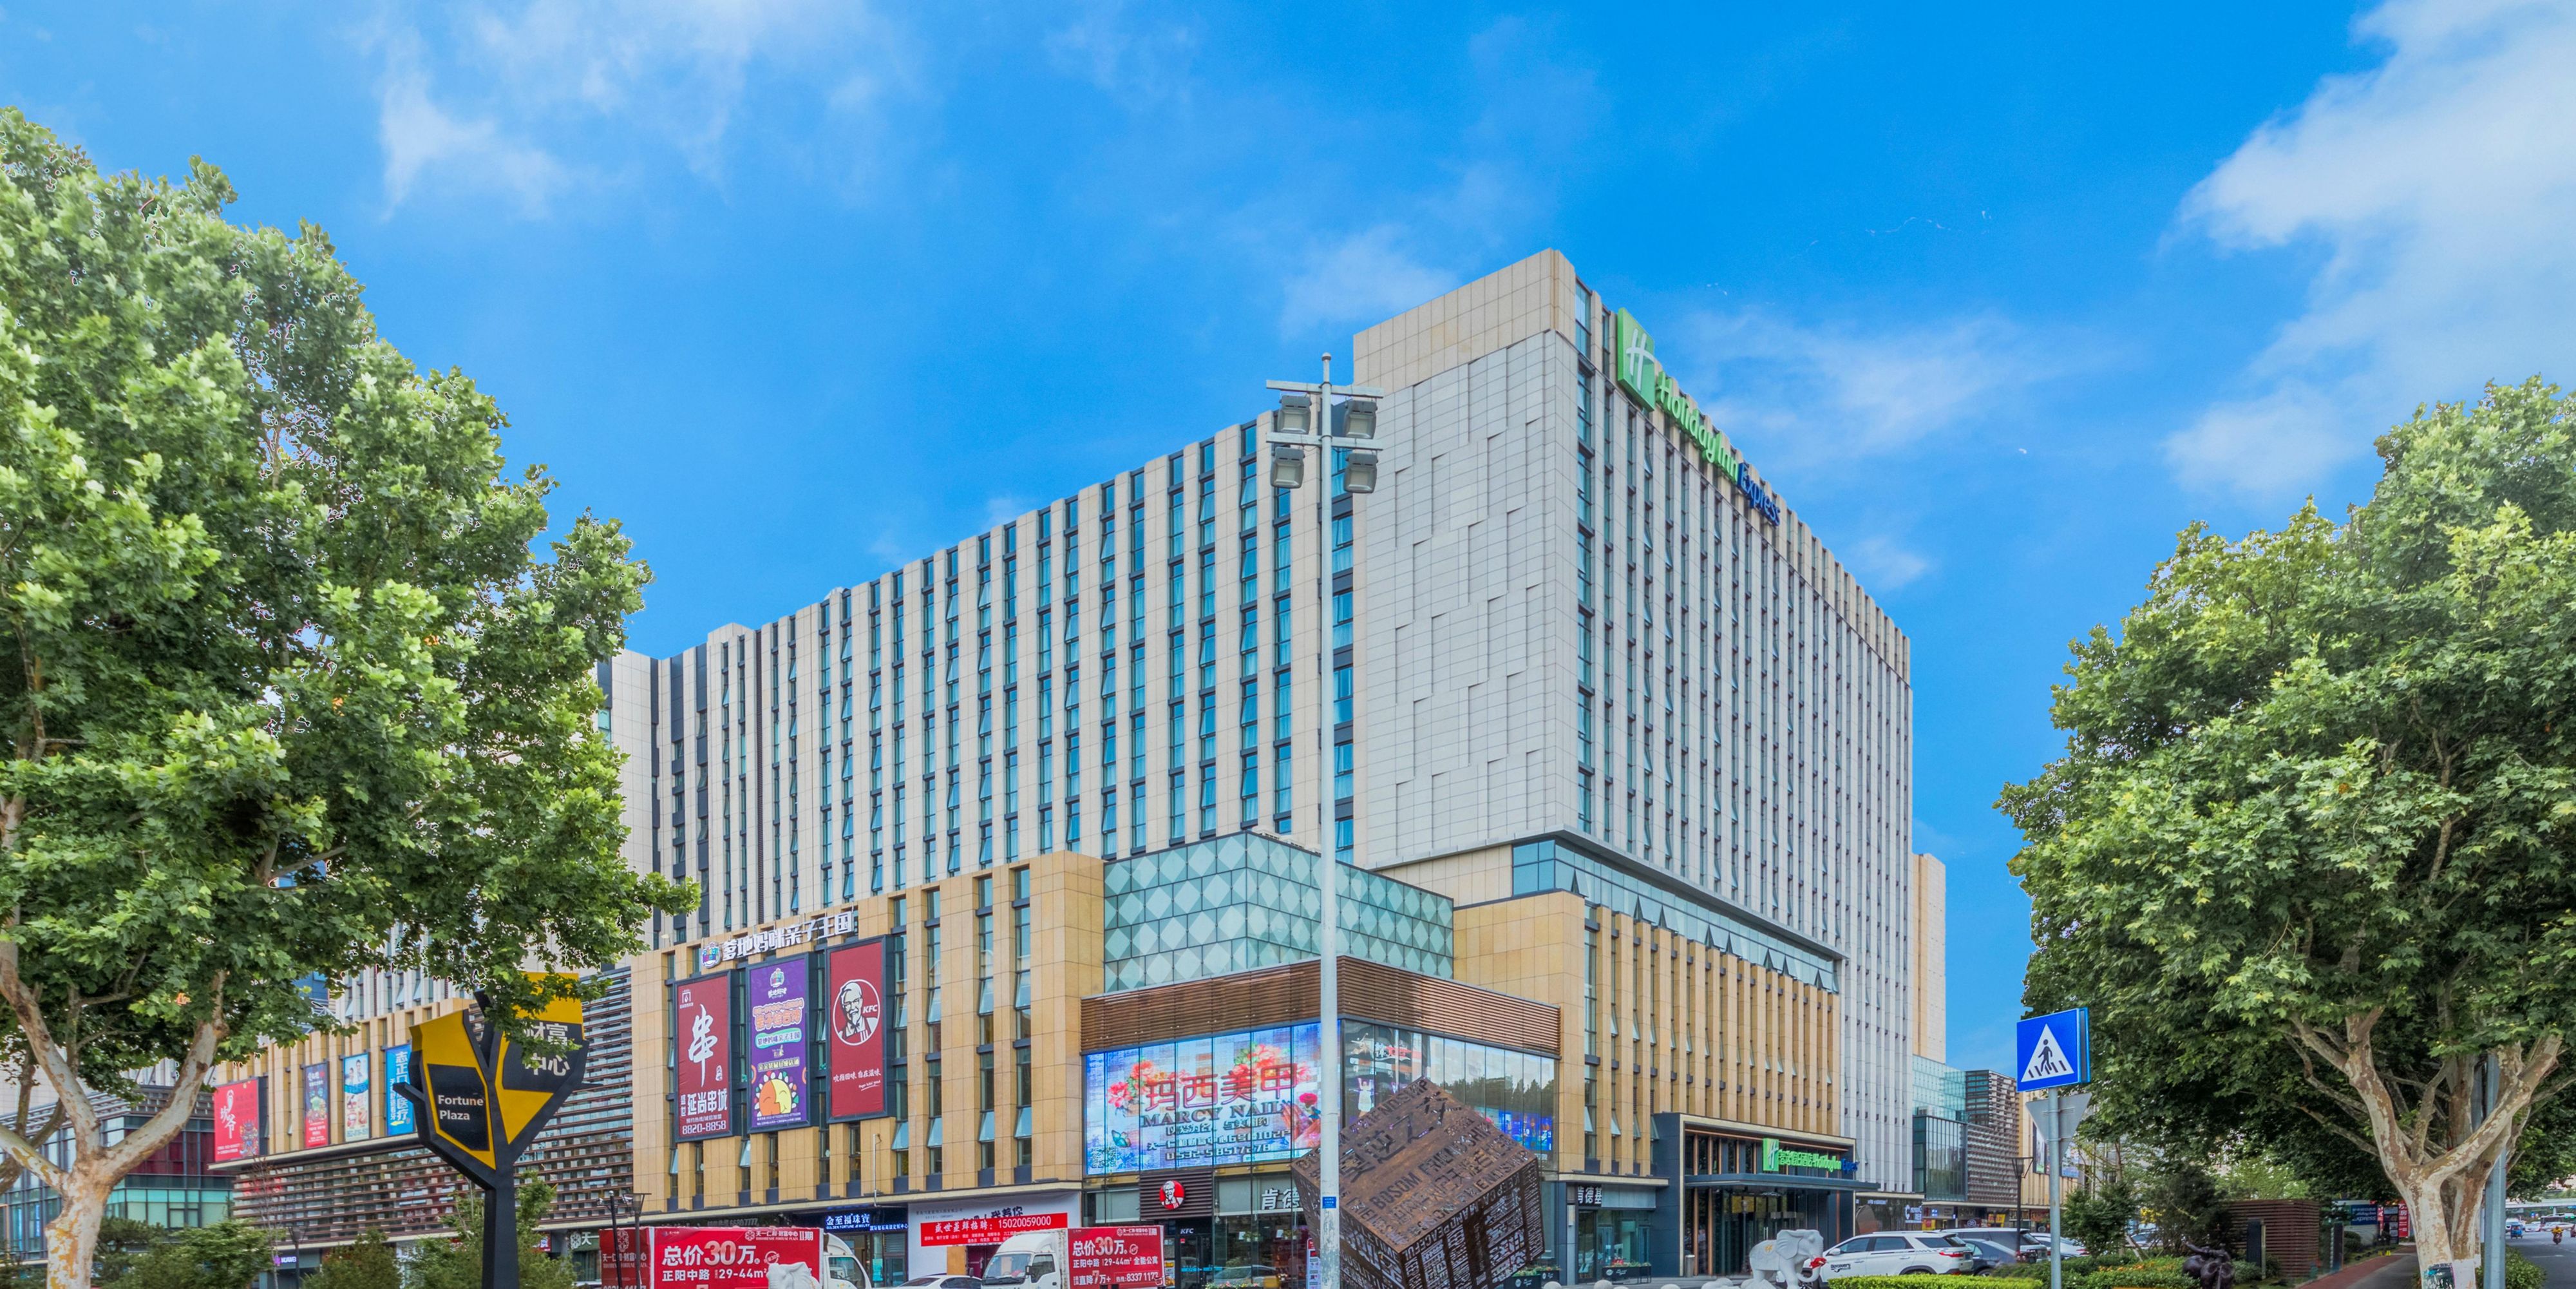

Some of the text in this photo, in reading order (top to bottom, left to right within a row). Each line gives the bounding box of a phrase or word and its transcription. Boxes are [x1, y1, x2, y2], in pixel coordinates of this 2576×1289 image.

[1655, 370, 1716, 463] Holiday
[1716, 431, 1739, 484] Inn
[1738, 463, 1781, 529] Express
[723, 911, 853, 961] 爹地妈咪亲子王国
[862, 1005, 878, 1013] KFC
[688, 1004, 718, 1087] 串
[525, 1053, 570, 1076] 中心
[858, 1068, 881, 1079] 自在滋味
[395, 1051, 409, 1121] 志正口医疗
[1145, 1063, 1298, 1111] 玛西美甲
[438, 1095, 484, 1106] Fortune
[688, 1088, 728, 1115] 延尚串城
[439, 1110, 470, 1120] Plaza
[1142, 1101, 1283, 1127] MARCY NAIL
[683, 1120, 726, 1134] 8820-8858
[1368, 1171, 1423, 1210] BOSOM
[1415, 1120, 1499, 1178] FRIENDSHIP
[998, 1216, 1052, 1228] 15020059000
[661, 1241, 756, 1266] 总价30万
[1072, 1237, 1124, 1256] 总价30万
[1073, 1259, 1100, 1268] 正阳中路
[1133, 1256, 1158, 1265] 全能公寓
[662, 1269, 710, 1281] 正阳中路
